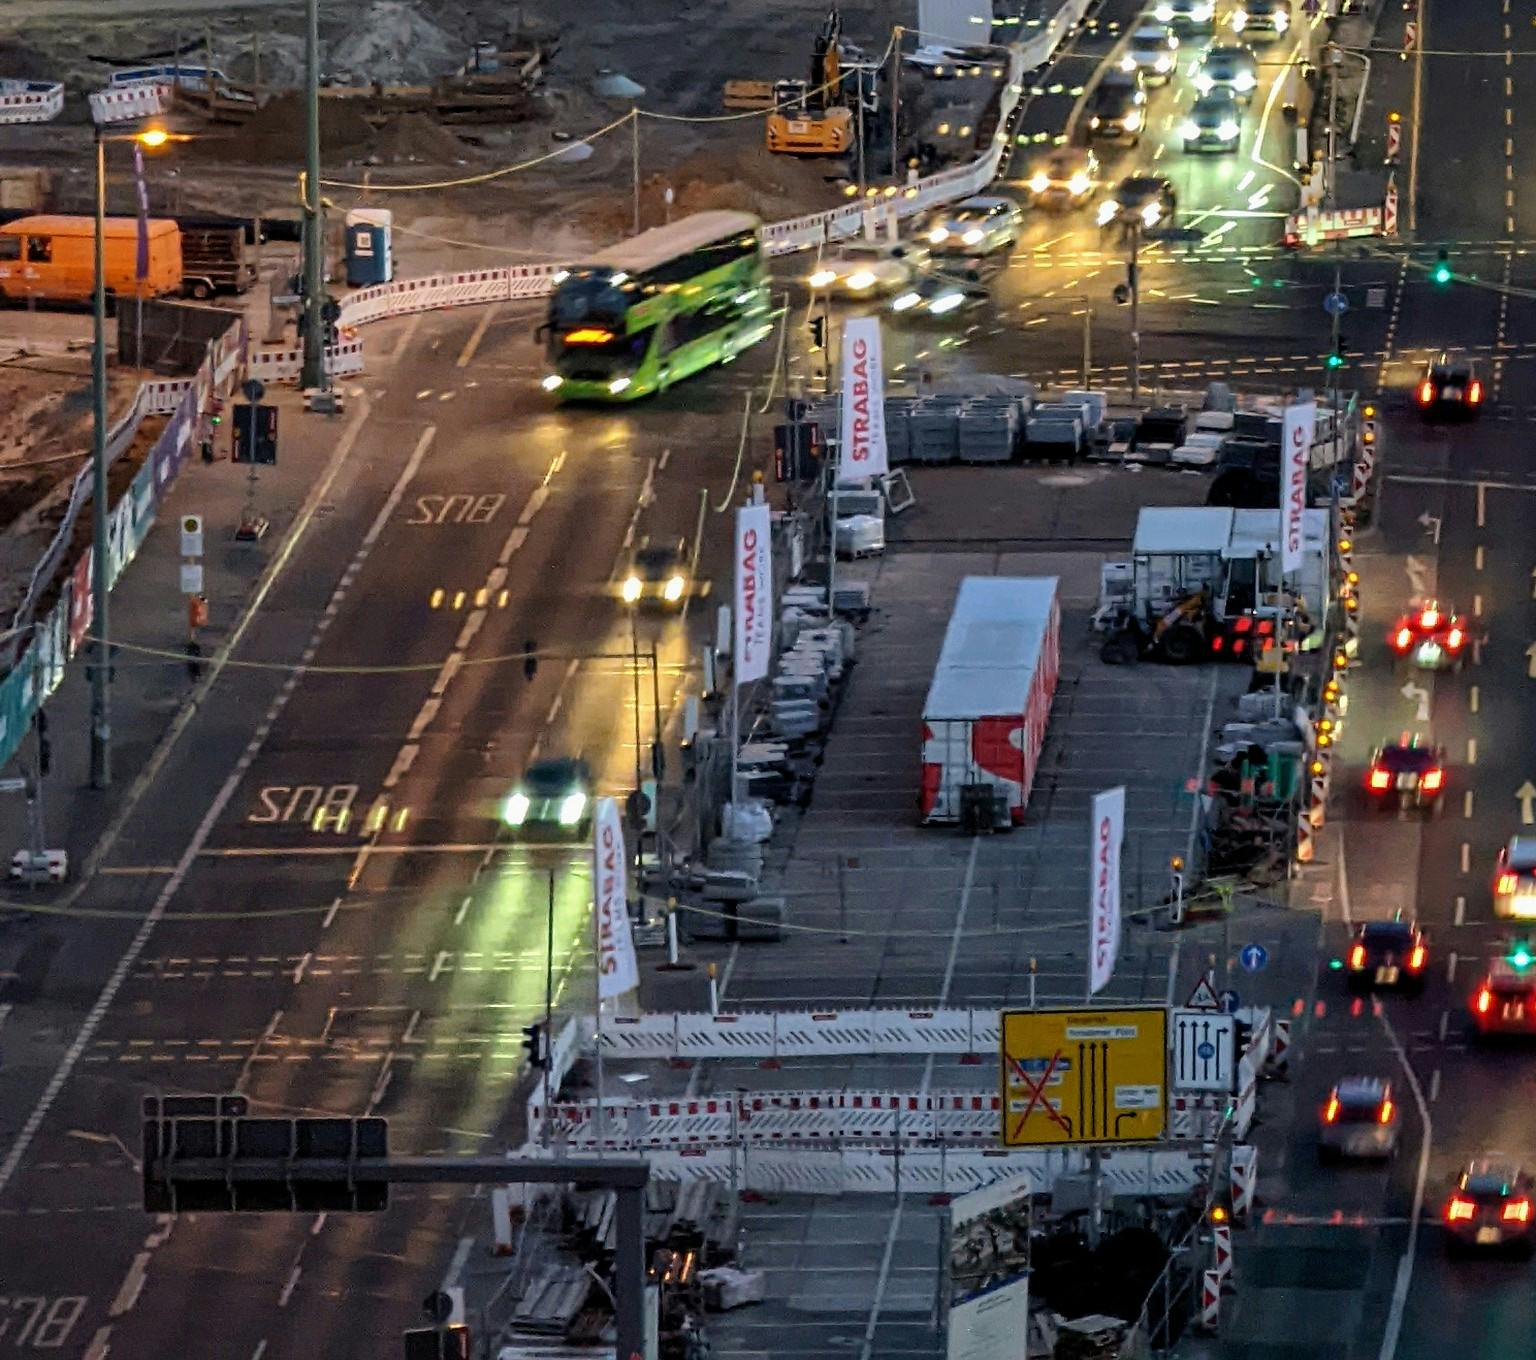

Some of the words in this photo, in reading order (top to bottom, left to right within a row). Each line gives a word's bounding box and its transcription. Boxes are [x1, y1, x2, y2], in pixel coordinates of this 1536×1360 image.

[852, 338, 869, 462] STRABAG
[406, 493, 507, 524] BUS
[1288, 426, 1305, 553] STRABAG
[248, 784, 359, 822] BUS
[600, 825, 617, 975] STRABAG
